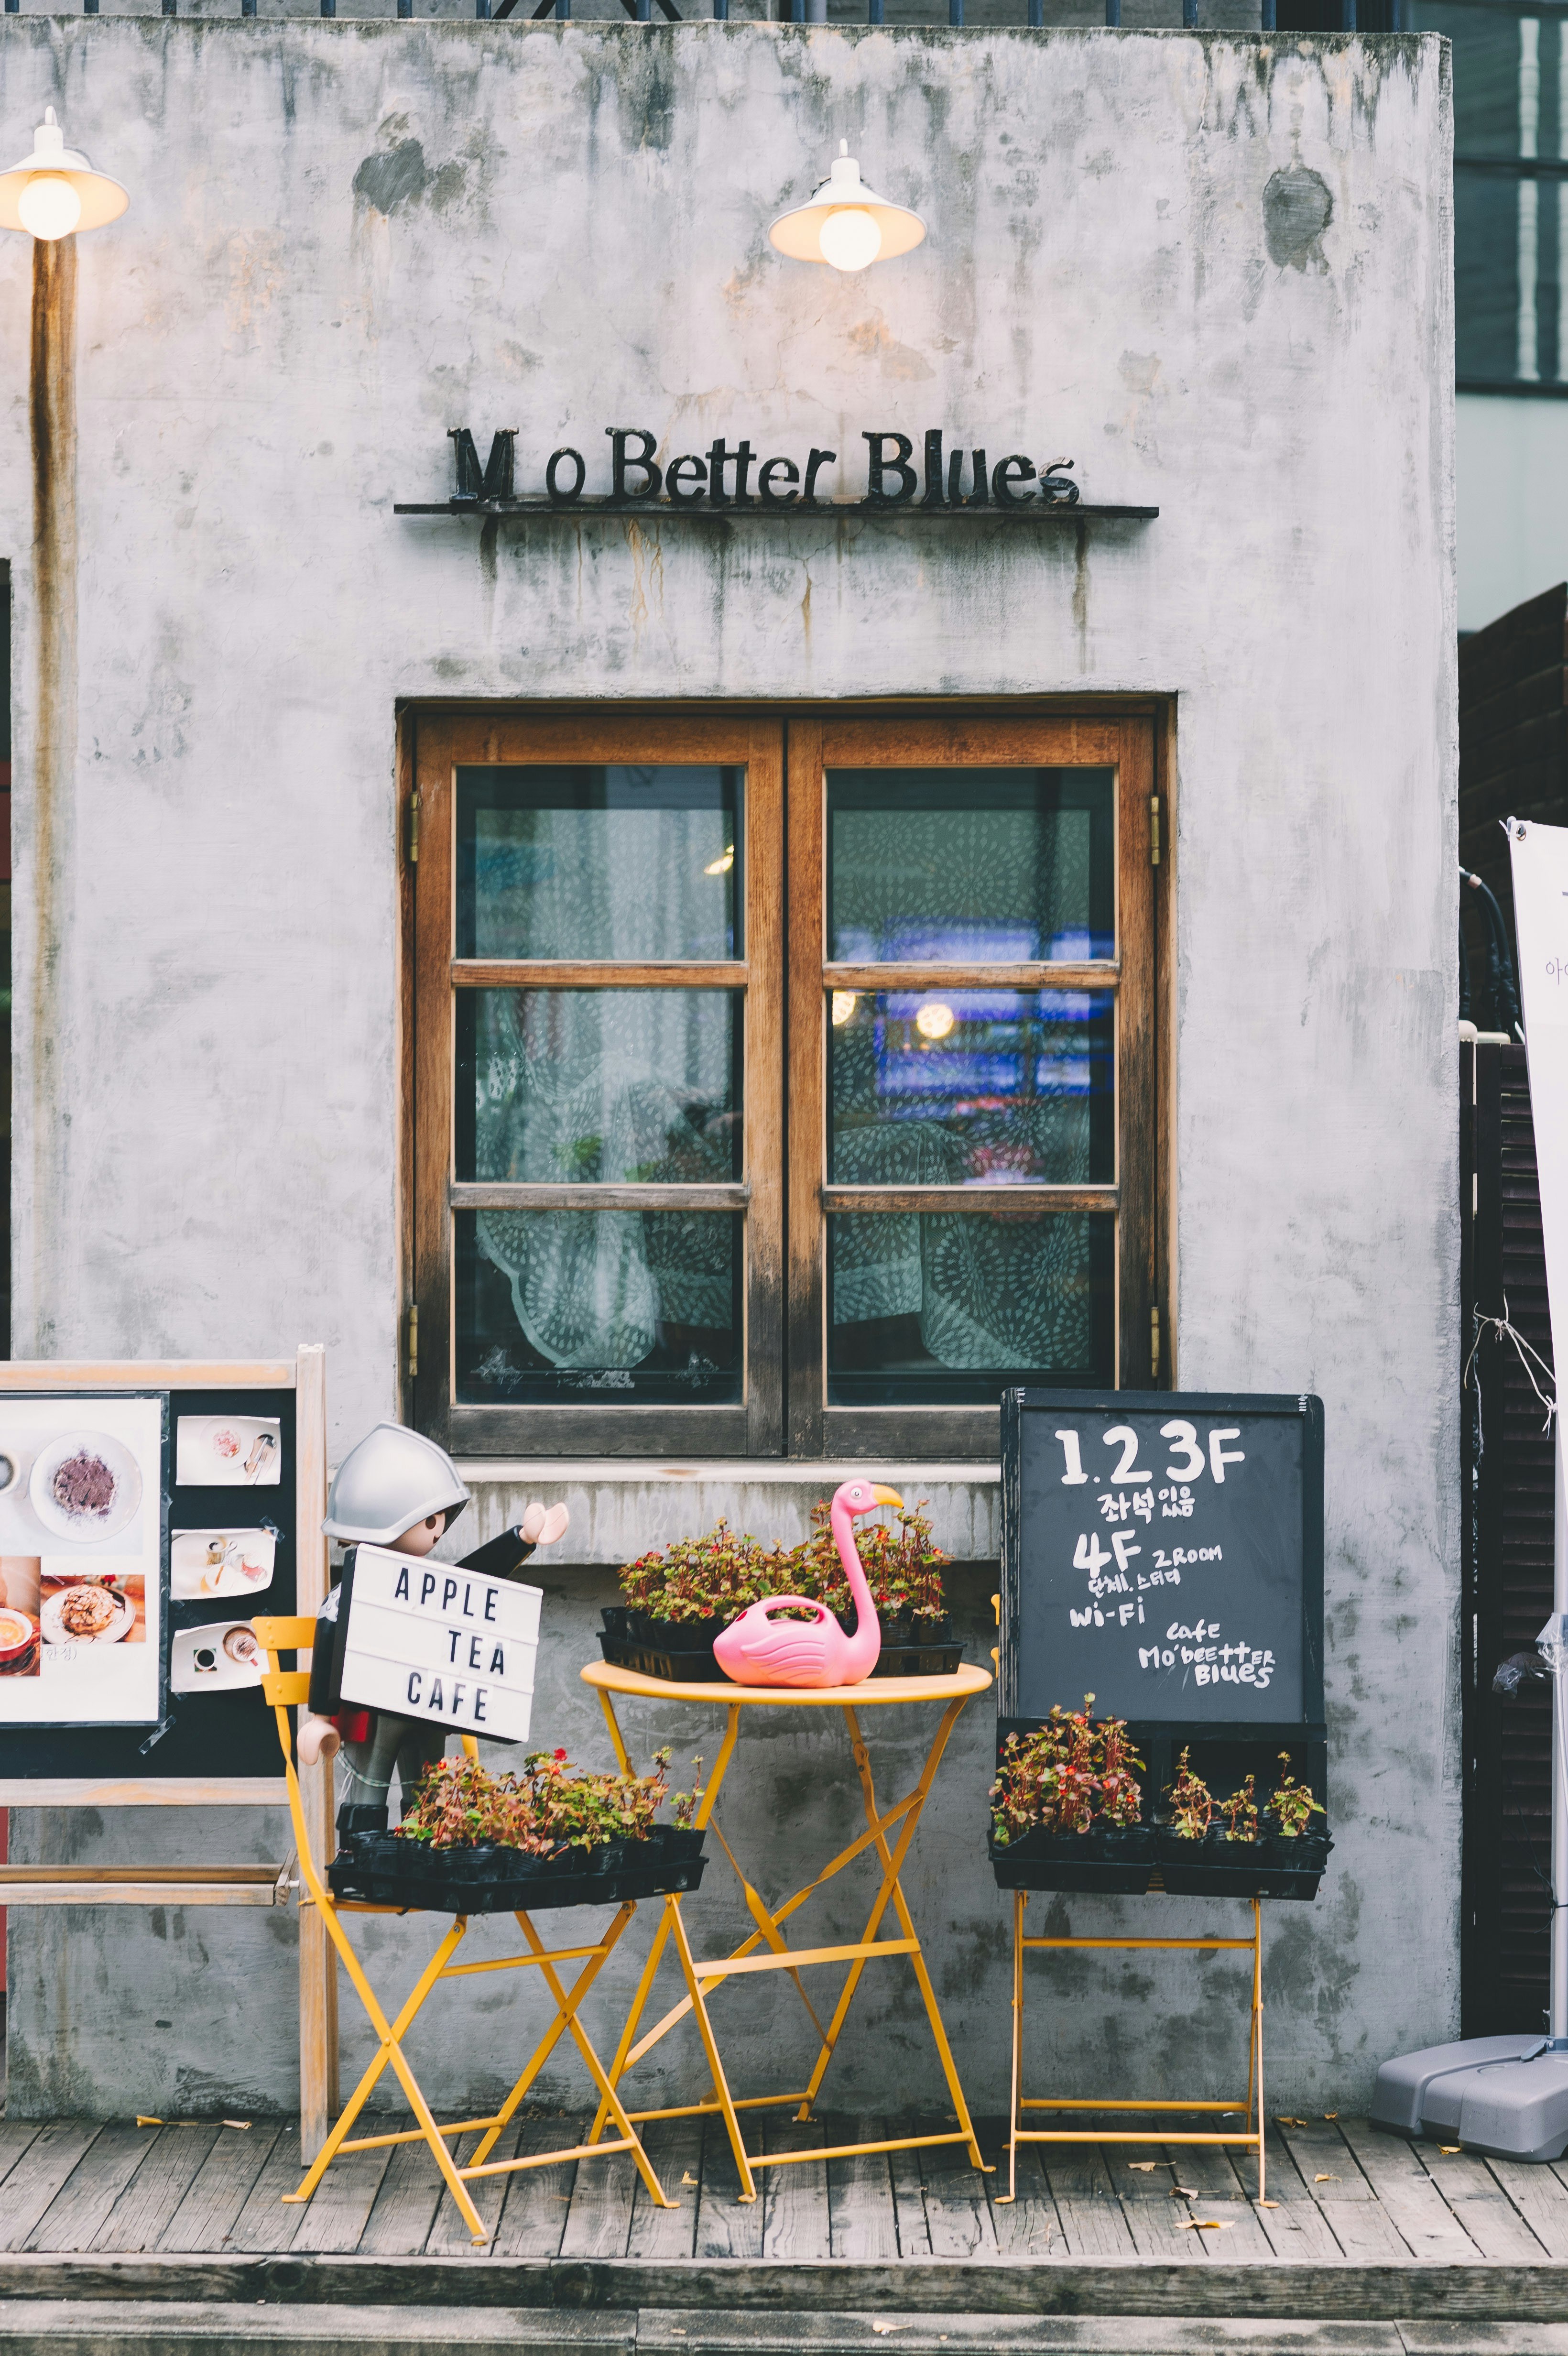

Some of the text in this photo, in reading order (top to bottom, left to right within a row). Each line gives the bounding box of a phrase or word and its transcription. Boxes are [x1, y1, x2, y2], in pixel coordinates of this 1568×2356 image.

[605, 427, 837, 503] Better
[861, 429, 1080, 505] Blues
[1097, 1485, 1196, 1524] 좌석 있음
[1072, 1529, 1142, 1579] 4F
[394, 1567, 499, 1622] APPLE
[1069, 1595, 1145, 1628] Wi-Fi
[448, 1630, 504, 1676] TEA
[1194, 1662, 1274, 1689] Blues
[407, 1671, 488, 1722] CAFE
